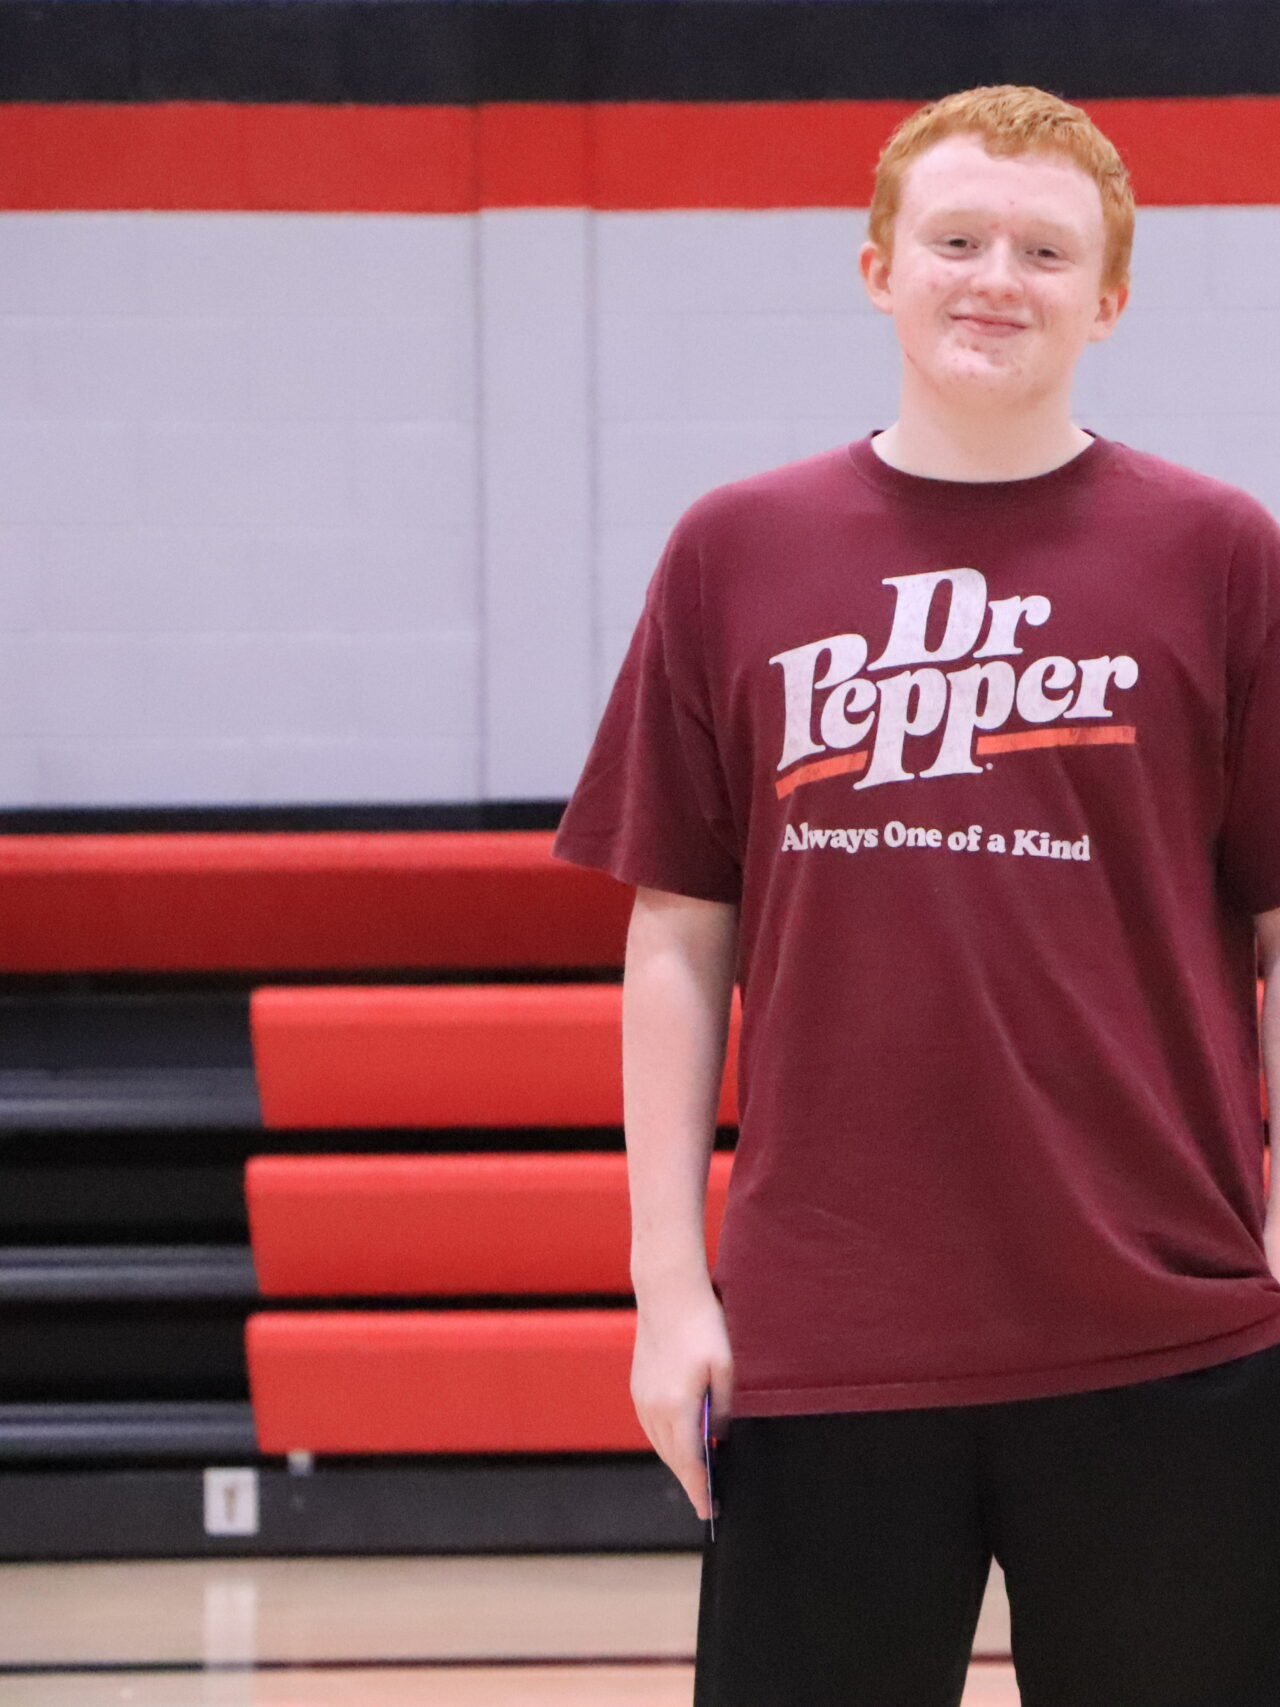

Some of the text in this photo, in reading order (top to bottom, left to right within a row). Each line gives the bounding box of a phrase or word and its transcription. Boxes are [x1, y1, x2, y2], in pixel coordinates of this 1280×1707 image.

[866, 567, 1052, 672] Dr
[768, 632, 1139, 791] Pepper
[781, 820, 1091, 862] Always One of a Kind
